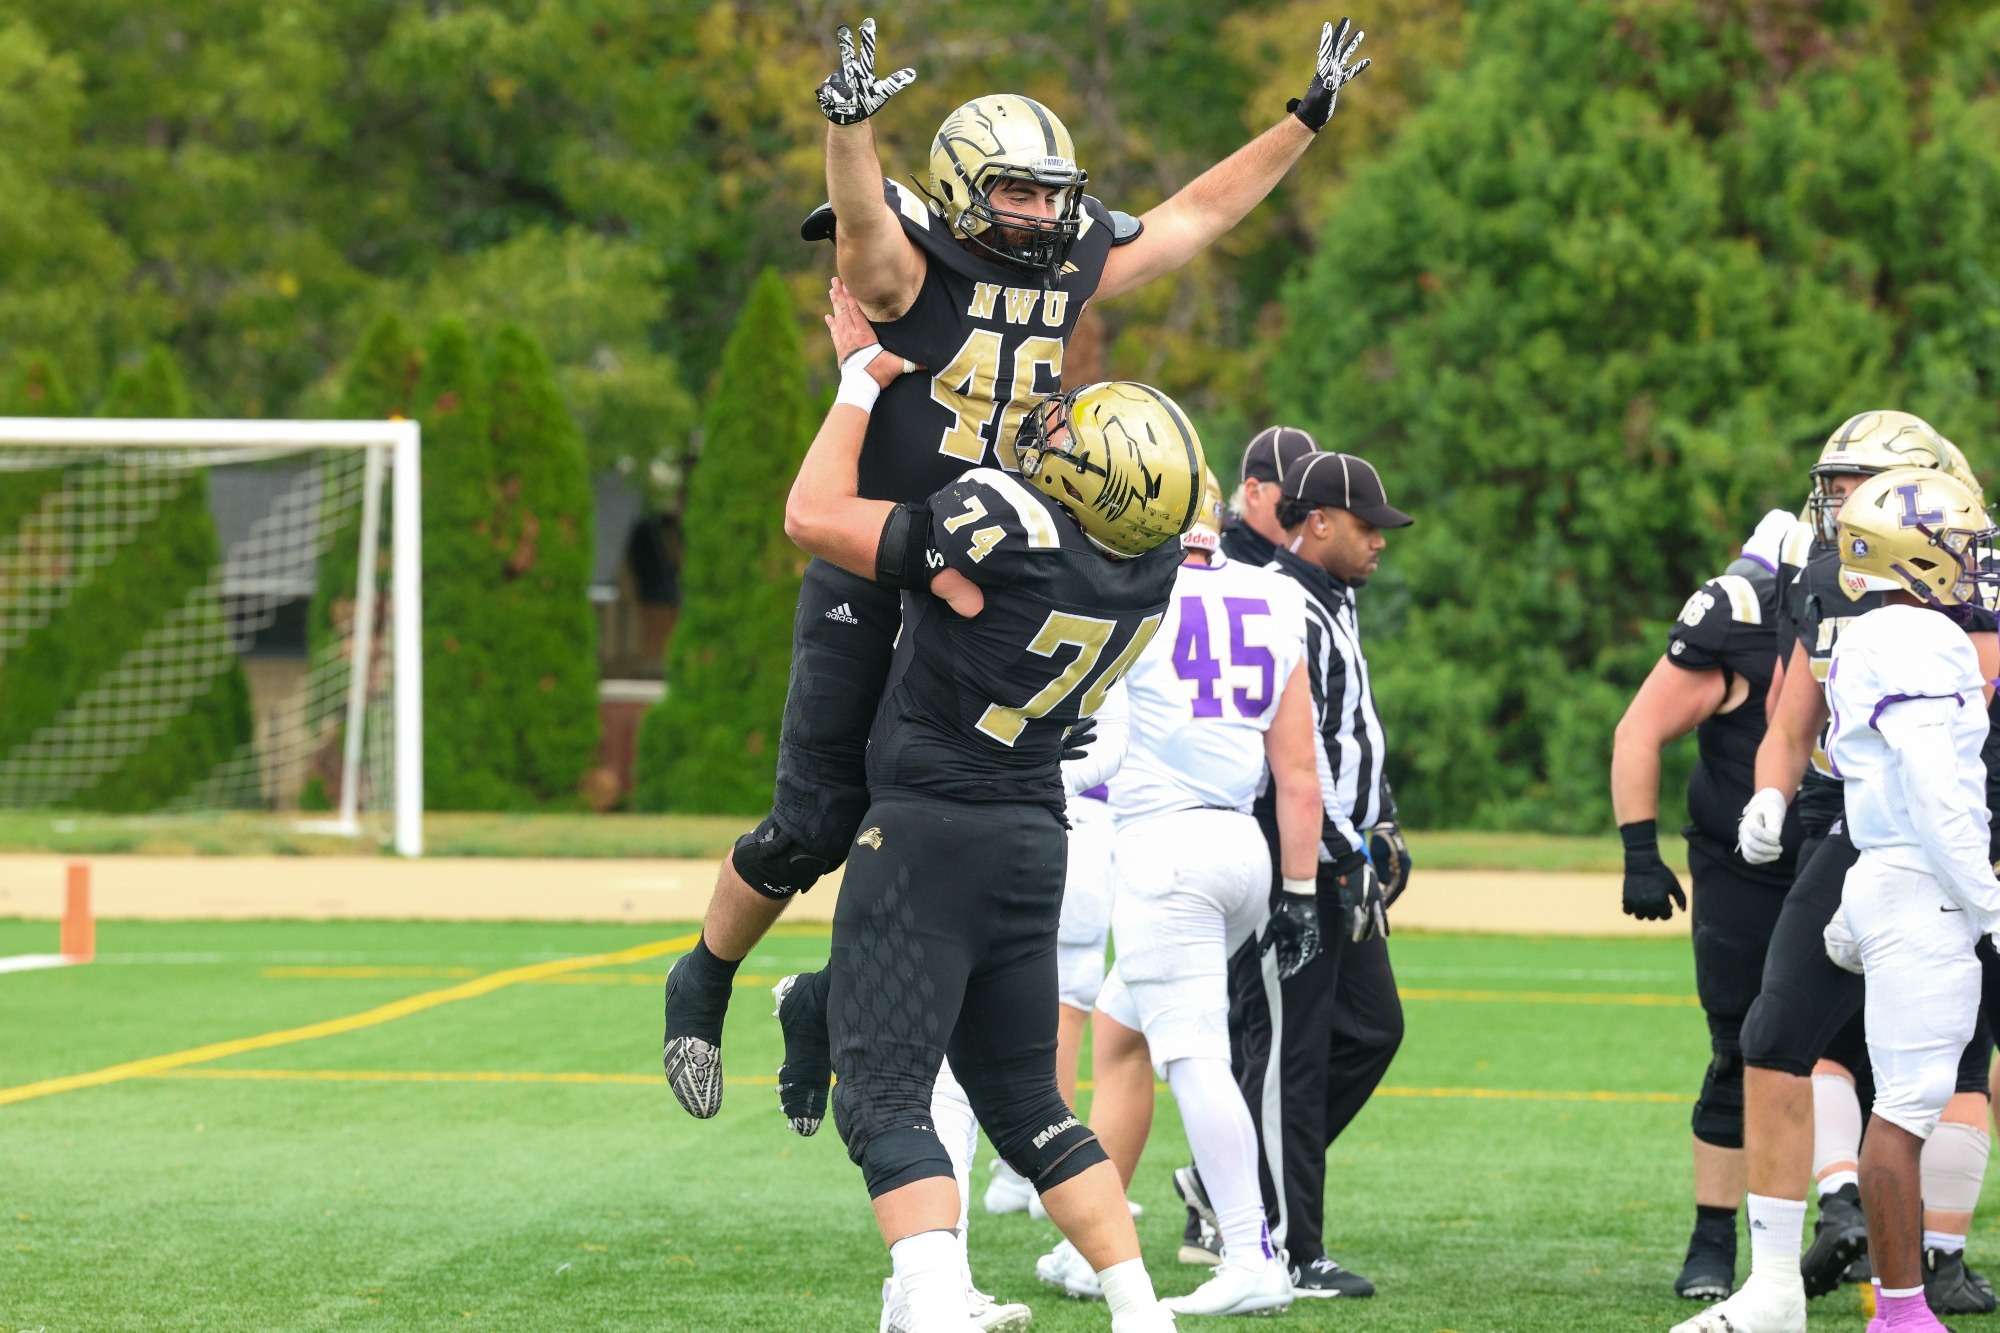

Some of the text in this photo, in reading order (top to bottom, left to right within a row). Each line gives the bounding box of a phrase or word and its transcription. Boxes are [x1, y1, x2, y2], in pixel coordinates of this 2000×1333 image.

[1043, 158, 1064, 167] FAMILY
[967, 282, 1069, 327] NWU
[930, 328, 1064, 472] 46
[1894, 483, 1947, 529] L
[943, 495, 1007, 564] 74
[1184, 532, 1216, 547] ddell
[825, 611, 858, 625] adidas
[1171, 596, 1275, 718] 45
[1040, 1116, 1082, 1142] Muelle
